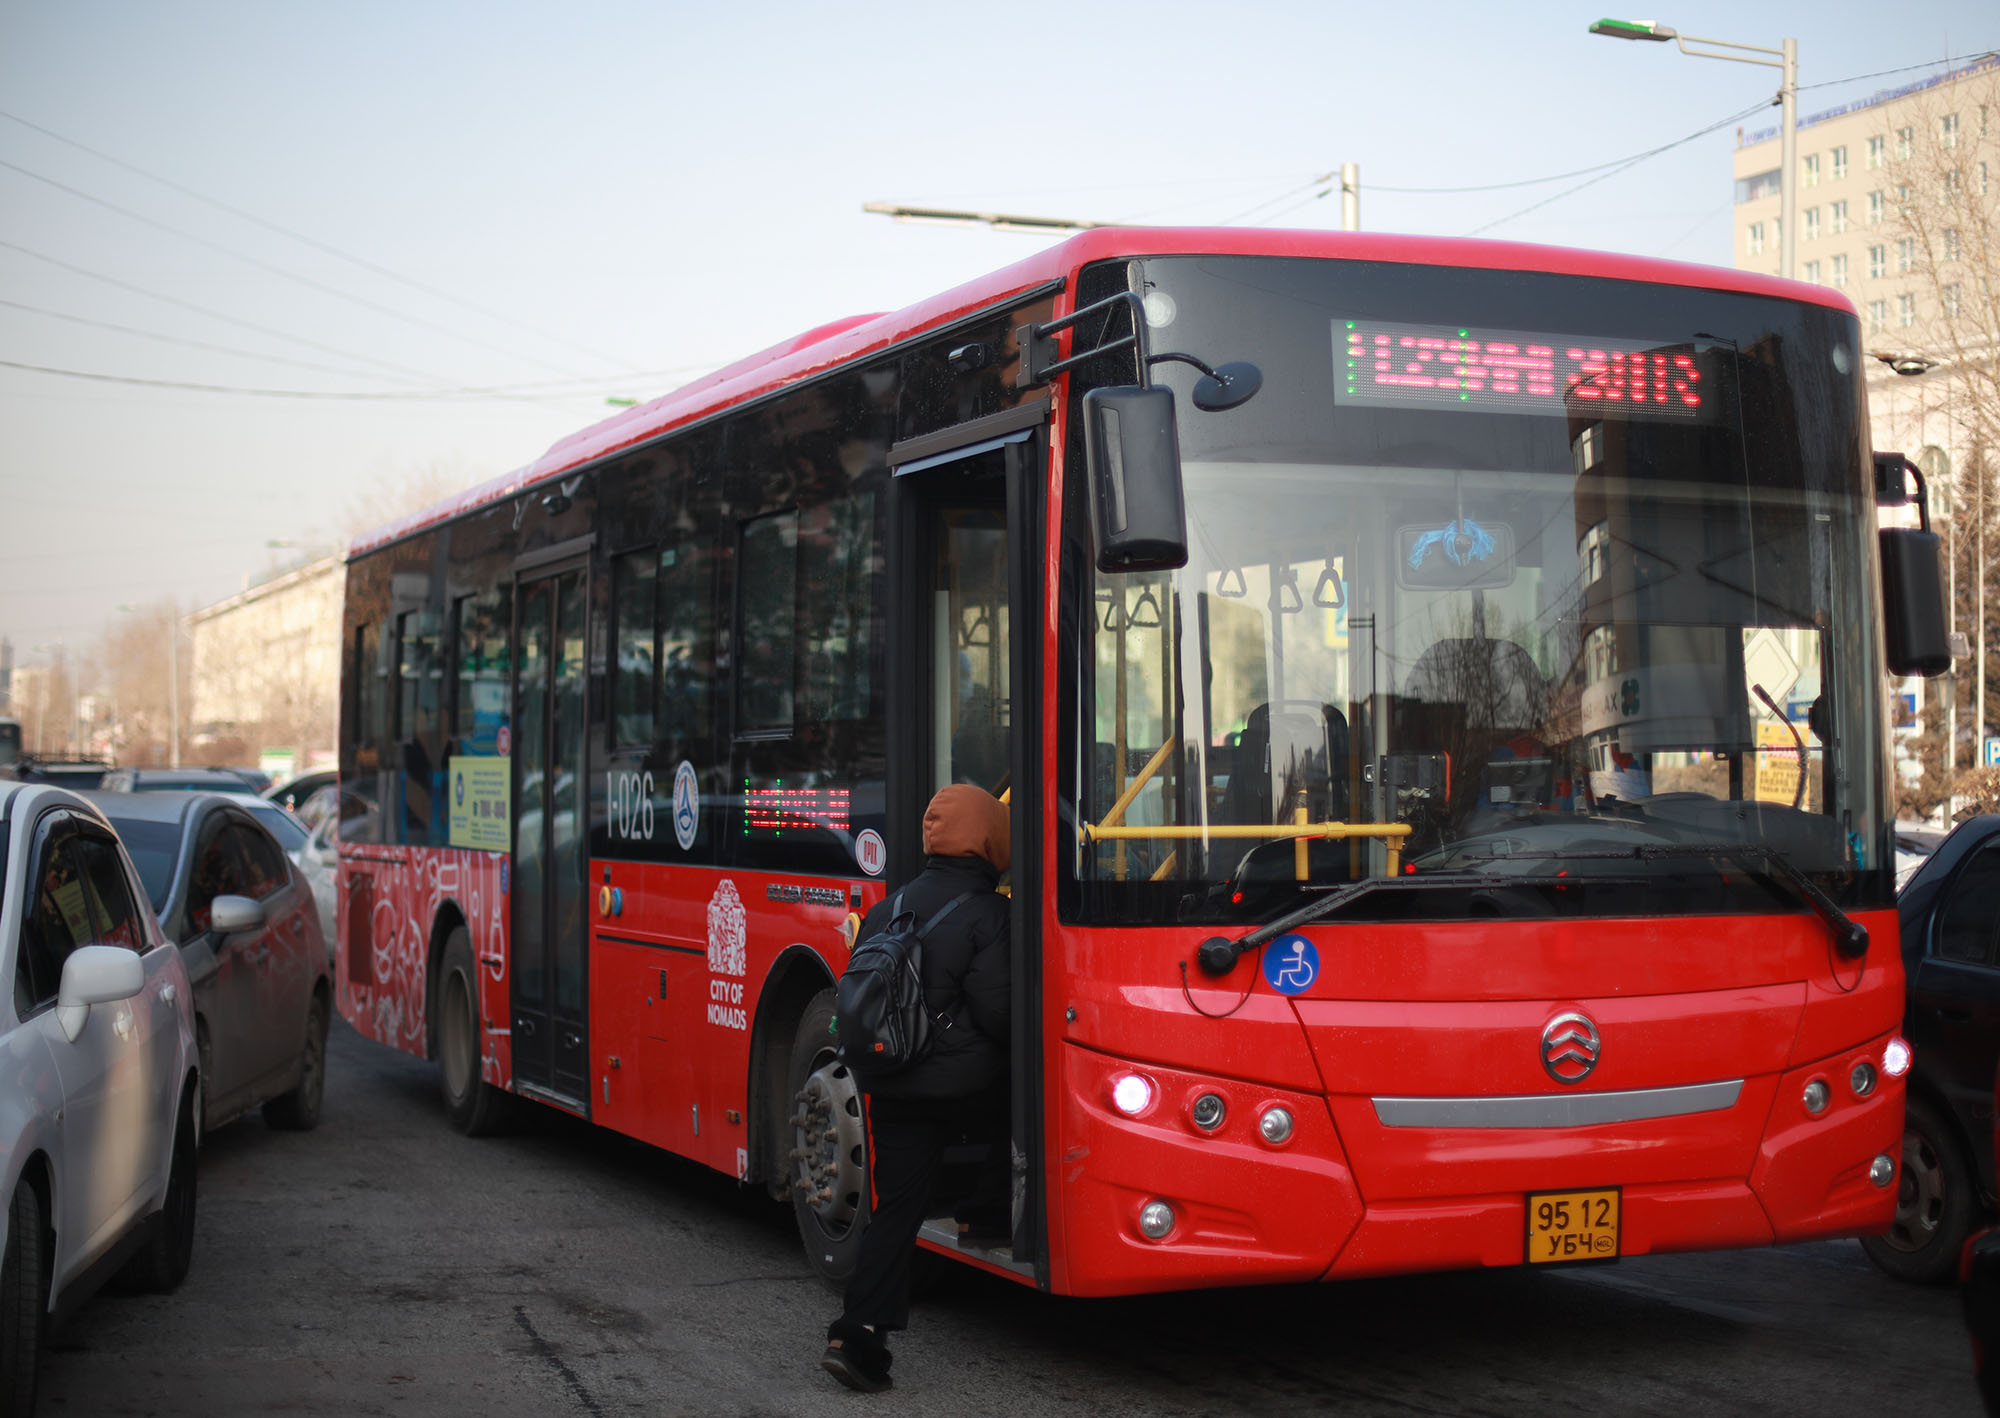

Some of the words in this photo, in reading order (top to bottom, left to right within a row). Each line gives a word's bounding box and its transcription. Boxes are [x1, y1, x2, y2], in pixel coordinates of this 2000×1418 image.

[710, 979, 731, 1003] CITY
[730, 983, 744, 1005] OF
[707, 1003, 747, 1031] NOMADS
[1538, 1200, 1570, 1231] 95
[1581, 1198, 1610, 1229] 12
